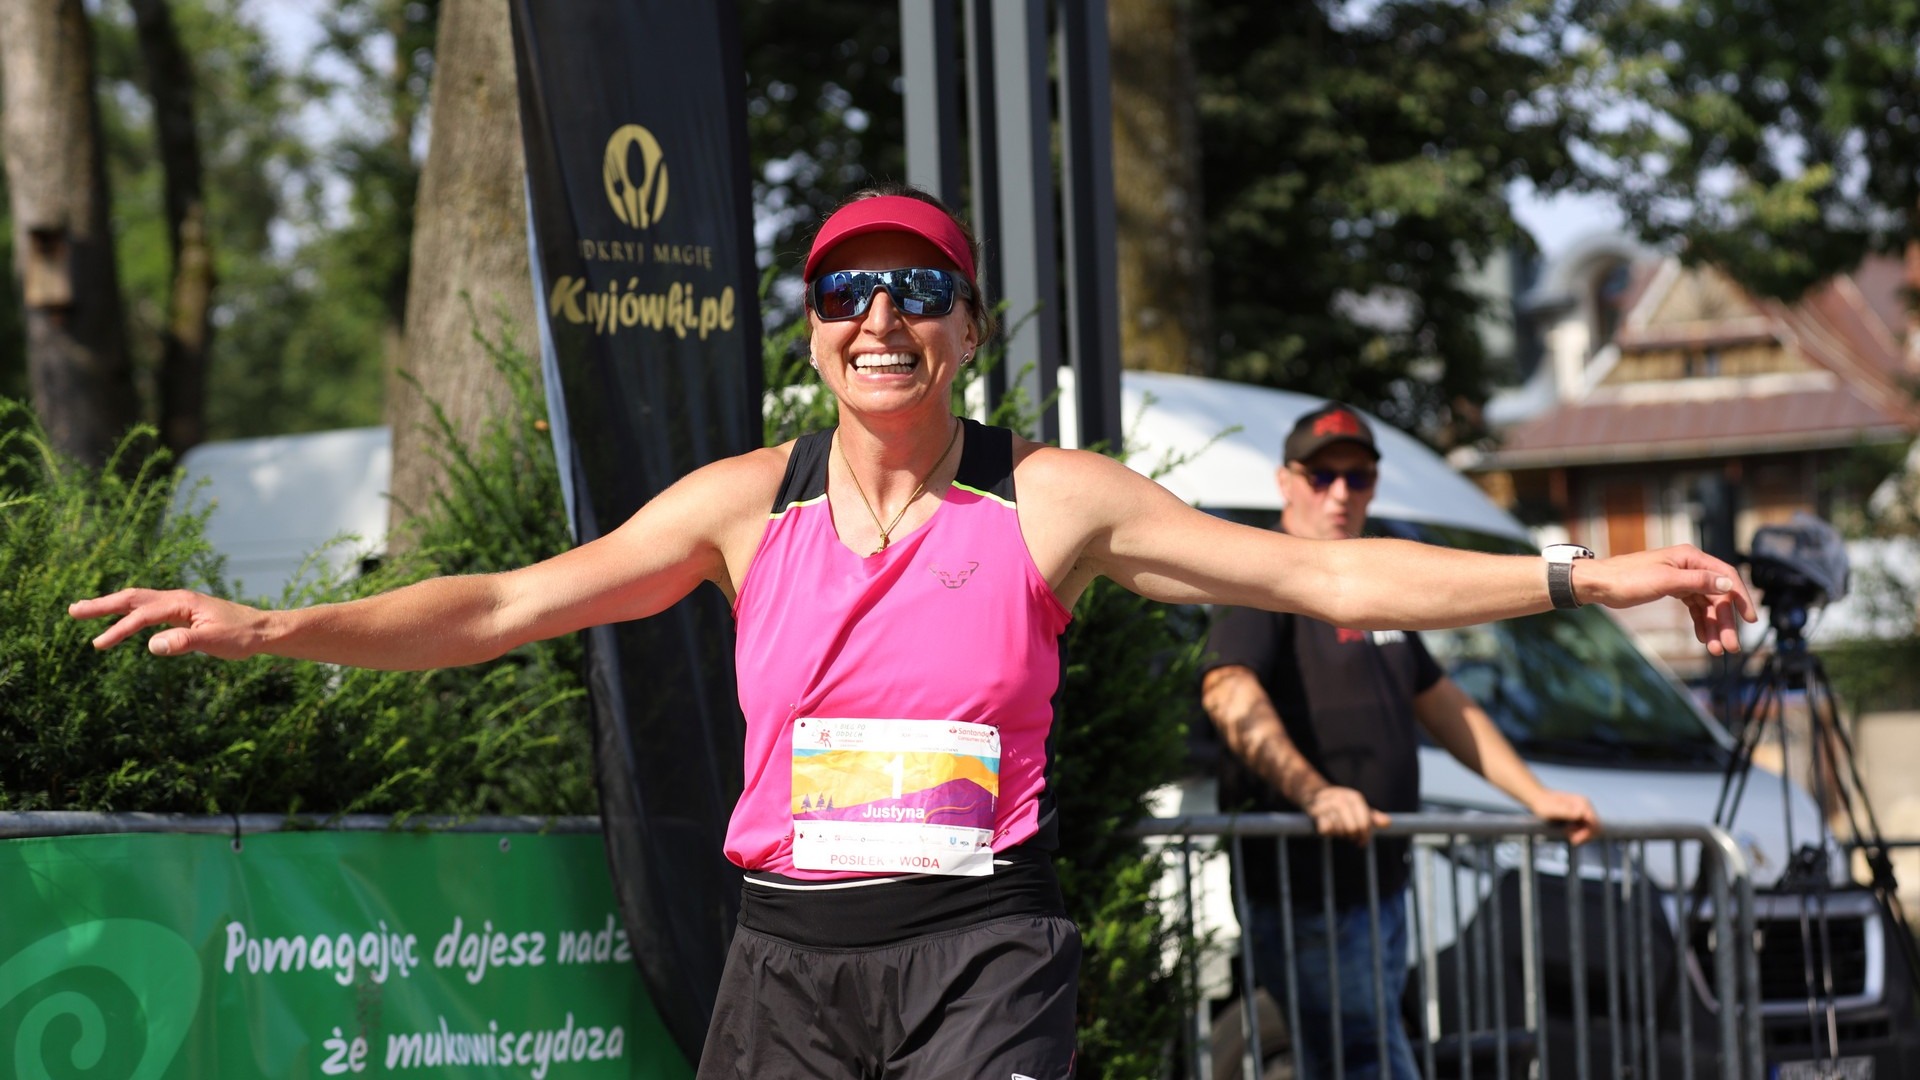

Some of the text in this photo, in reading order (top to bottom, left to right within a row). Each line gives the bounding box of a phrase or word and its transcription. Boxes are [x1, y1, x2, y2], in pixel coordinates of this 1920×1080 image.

[579, 239, 712, 271] DKRYJ MAGIĘ
[883, 754, 905, 800] 1
[862, 805, 925, 822] Justyna
[830, 854, 885, 867] POSIŁEK
[899, 856, 940, 869] WODA
[224, 919, 419, 986] Pomagając
[433, 916, 546, 985] dajesz
[320, 1012, 625, 1080] że mukowiscydoza
